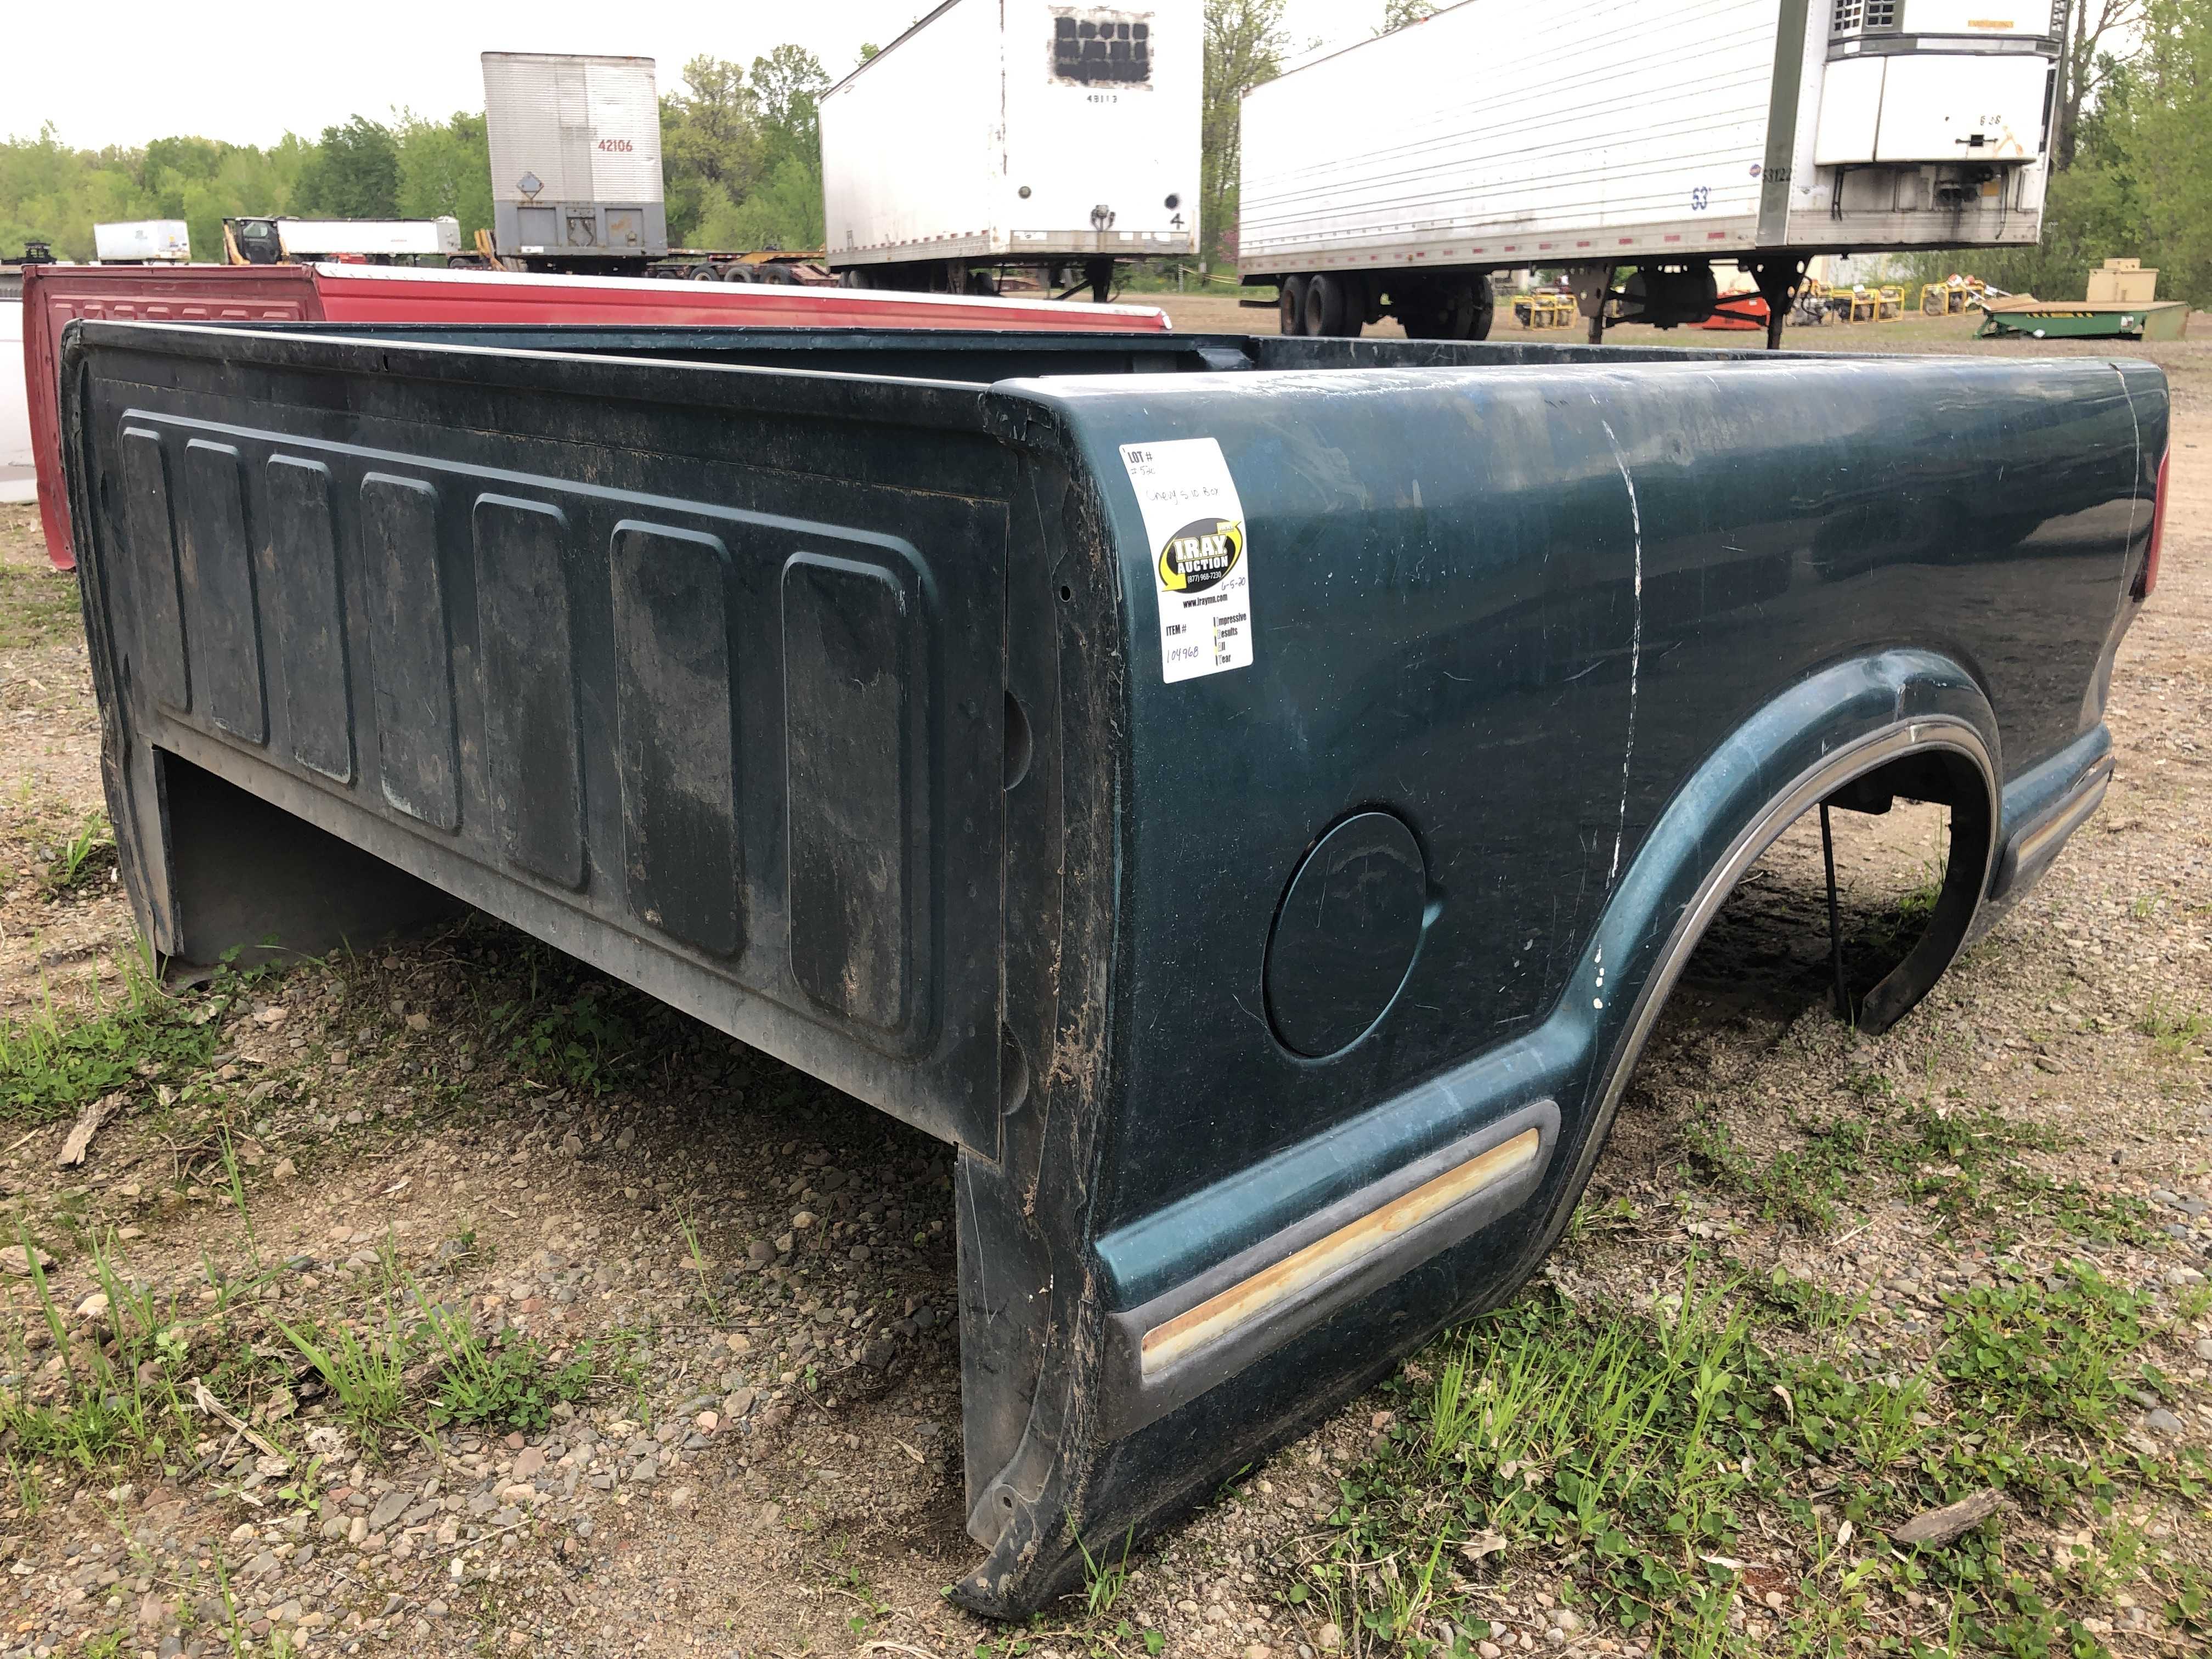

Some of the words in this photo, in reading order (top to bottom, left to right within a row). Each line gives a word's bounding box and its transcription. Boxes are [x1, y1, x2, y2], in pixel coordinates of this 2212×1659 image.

[597, 139, 633, 152] 42106
[1170, 213, 1185, 229] 4
[1127, 451, 1144, 463] LOT
[1146, 452, 1153, 461] #
[1177, 555, 1228, 574] AUCTION
[1187, 574, 1200, 584] (877)
[1200, 571, 1222, 581] 968-7230
[1183, 594, 1228, 608] www.iraymn.com
[1216, 613, 1246, 627] Impressive
[1166, 624, 1181, 636] ITEM
[1182, 624, 1187, 633] #
[1217, 628, 1238, 639] Results
[1167, 646, 1199, 663] 104968
[1218, 654, 1231, 664] Year
